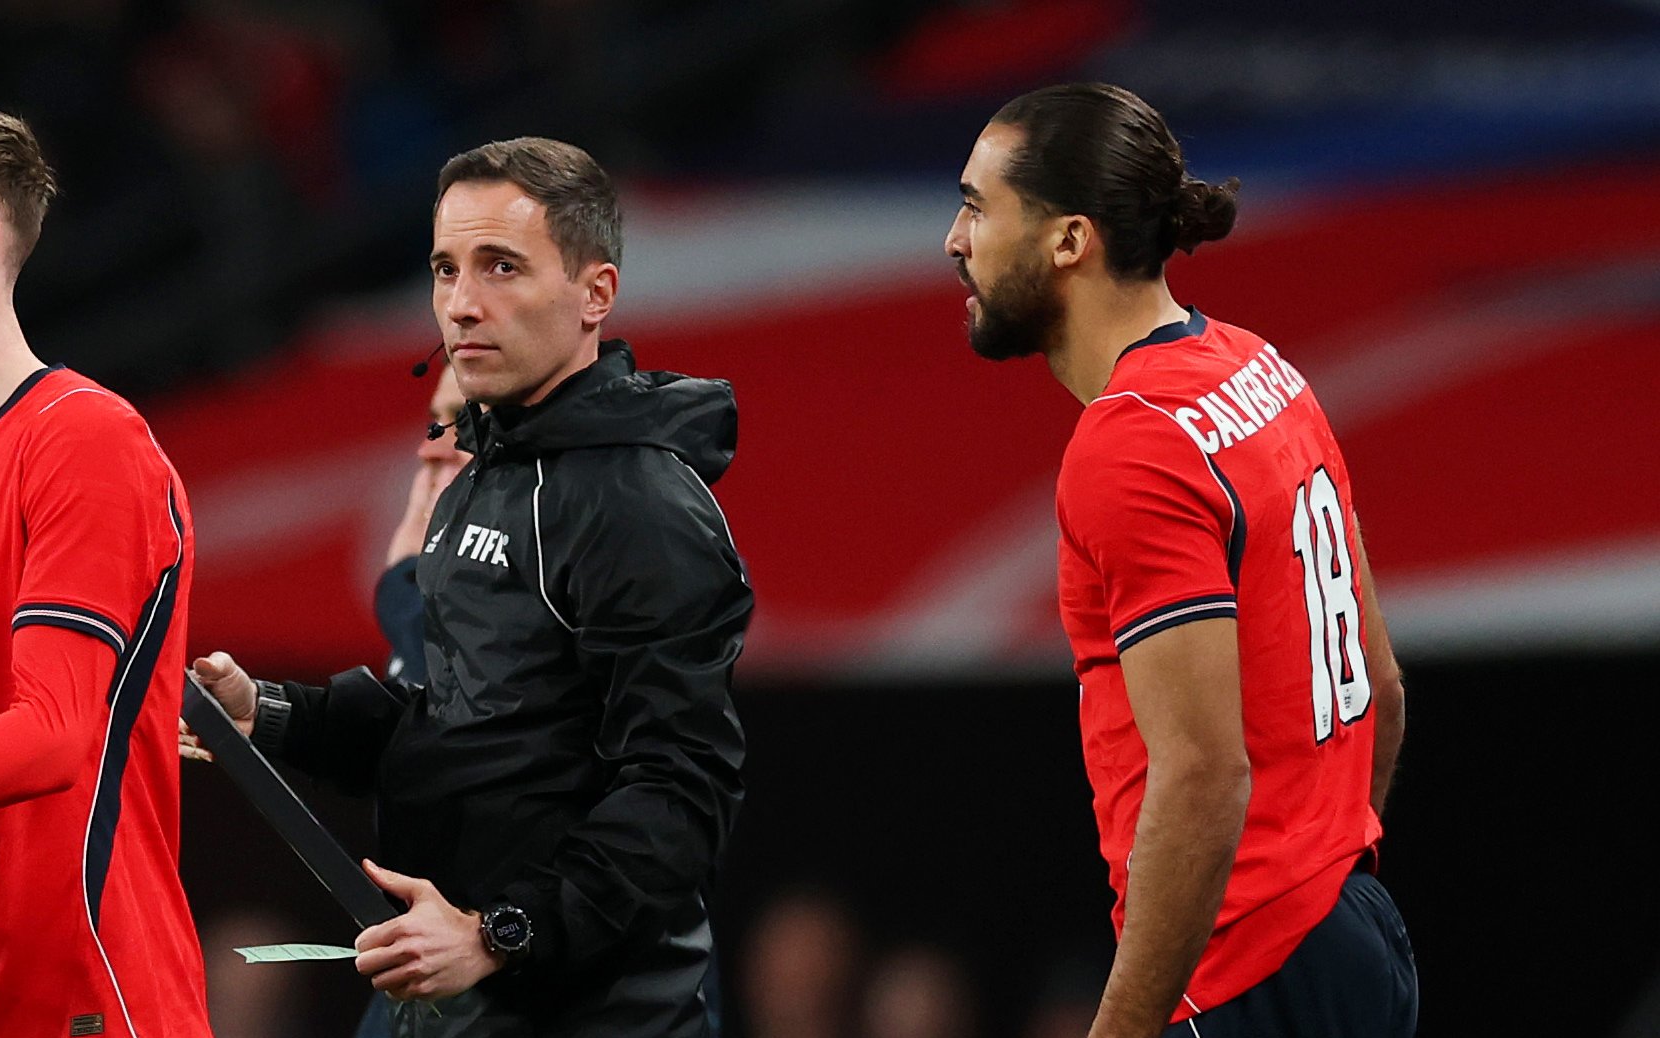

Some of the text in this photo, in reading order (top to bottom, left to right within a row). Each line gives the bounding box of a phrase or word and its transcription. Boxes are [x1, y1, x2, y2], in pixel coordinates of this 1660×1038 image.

[1175, 342, 1308, 455] CALVERT-LE
[457, 523, 509, 568] FIFA
[1291, 463, 1372, 747] 18
